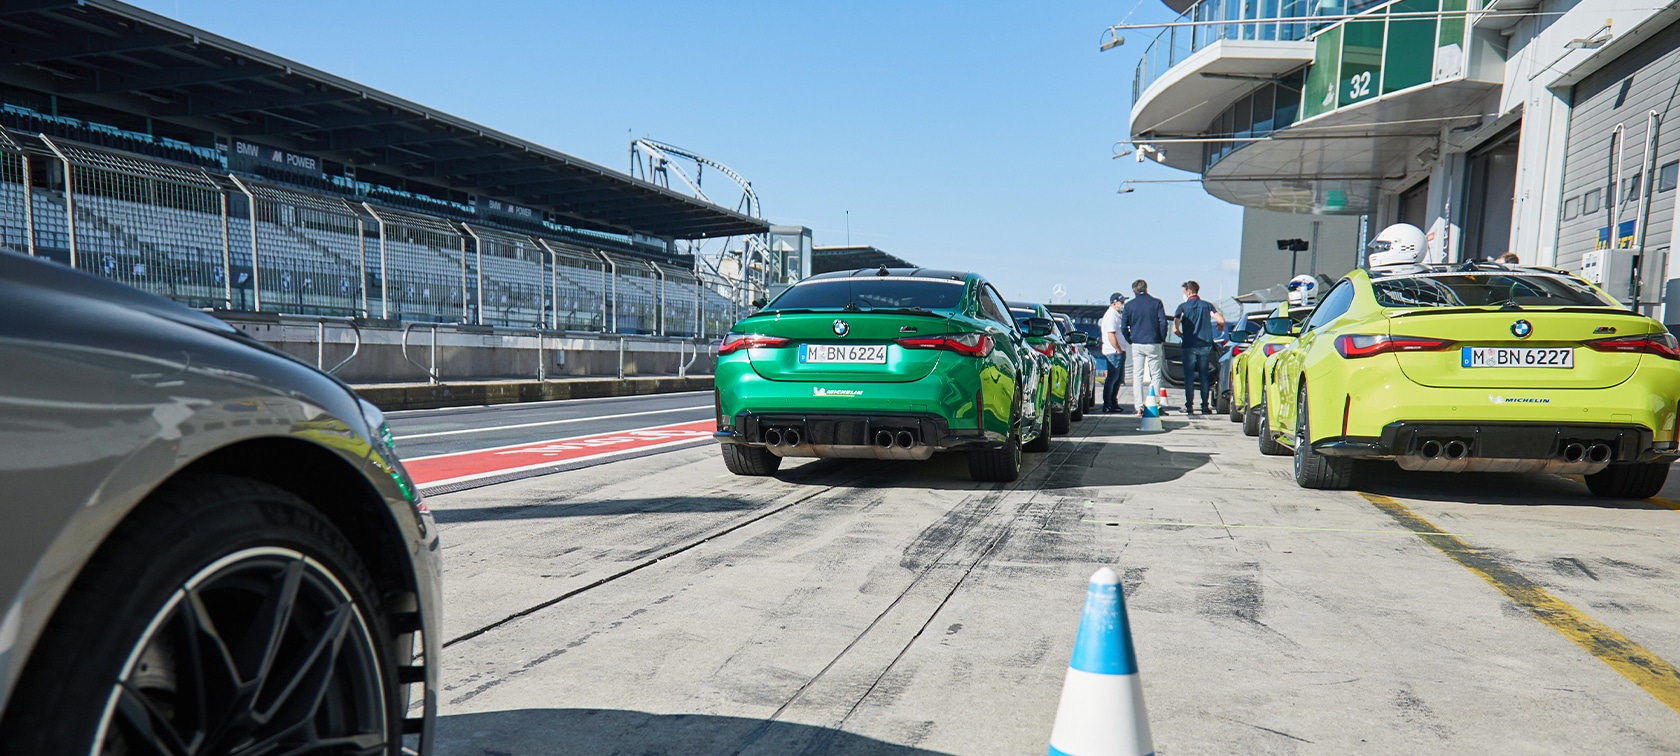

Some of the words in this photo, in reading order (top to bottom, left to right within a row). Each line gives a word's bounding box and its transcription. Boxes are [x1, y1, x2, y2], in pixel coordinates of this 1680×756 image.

[1350, 71, 1371, 99] 32
[236, 141, 259, 158] BMW
[286, 153, 316, 170] POWER
[515, 205, 532, 217] POWER
[808, 347, 818, 360] M
[827, 347, 846, 360] BN
[849, 347, 884, 360] 6224
[1473, 350, 1485, 365] M
[1497, 350, 1520, 365] BN
[1525, 350, 1570, 365] 6227
